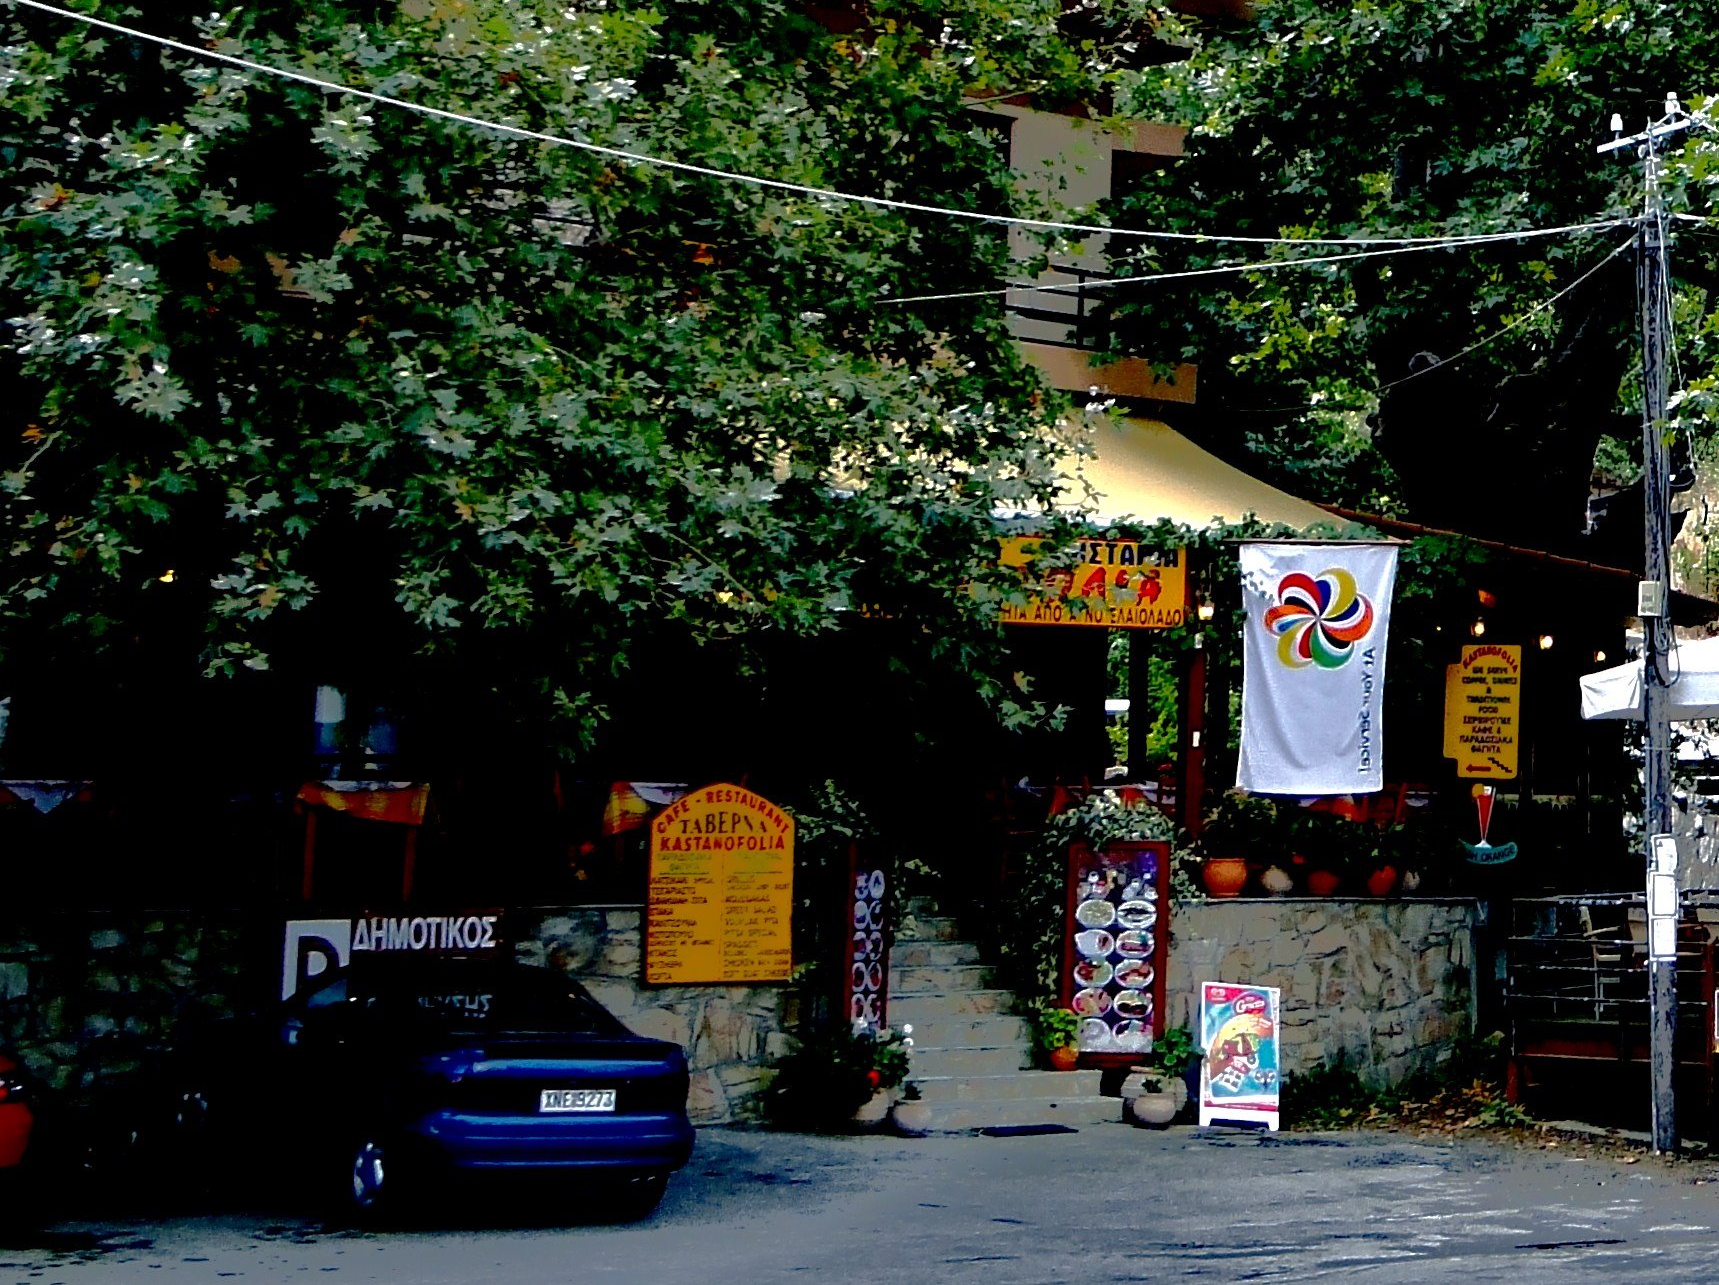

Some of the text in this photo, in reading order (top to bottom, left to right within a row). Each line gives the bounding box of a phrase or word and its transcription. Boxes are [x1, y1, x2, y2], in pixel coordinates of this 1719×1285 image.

[1035, 605, 1062, 622] ΑΠΟ
[1110, 607, 1182, 626] ΕΛΑΙΟΛΑΔΟ
[657, 800, 690, 834] CAFE
[706, 790, 790, 834] RESTAURANT
[660, 836, 785, 851] KASTANOFOLIA
[352, 916, 498, 951] ΔΗΜΟΤΙΚΟΣ
